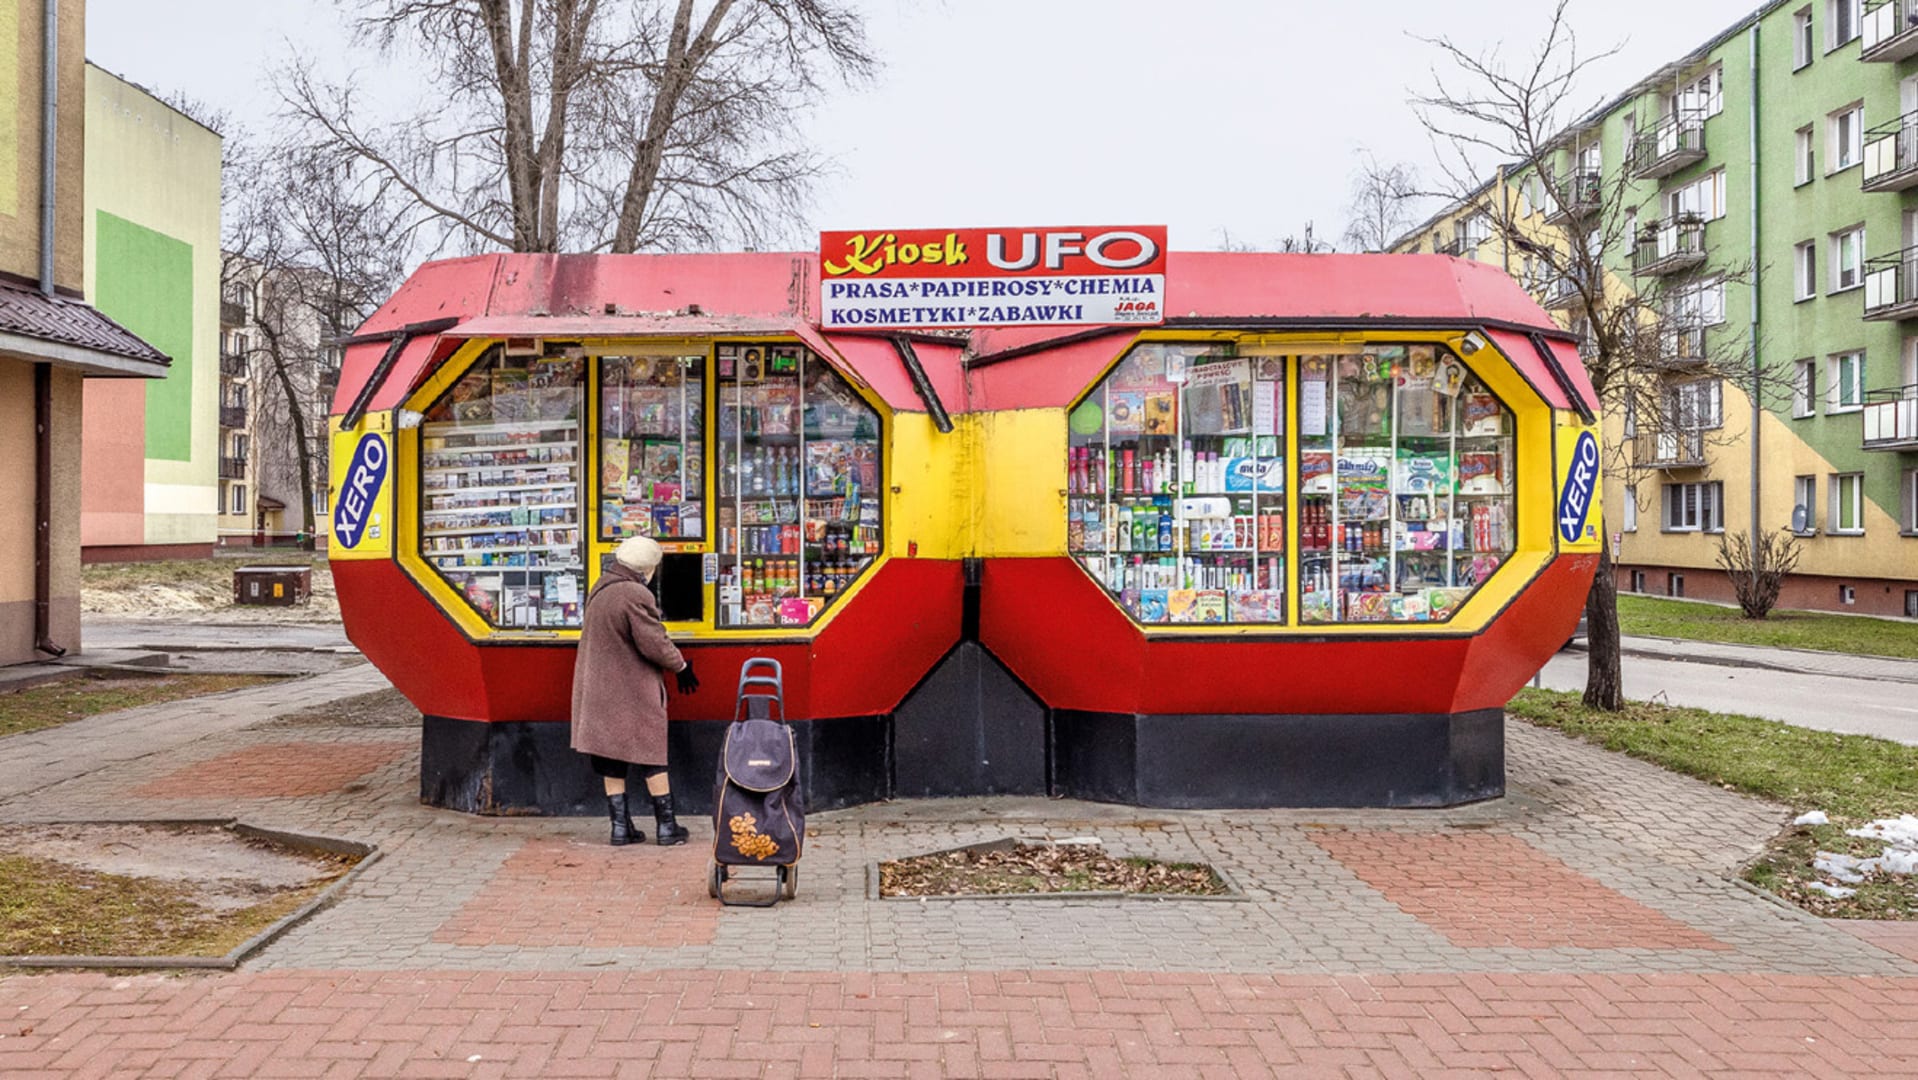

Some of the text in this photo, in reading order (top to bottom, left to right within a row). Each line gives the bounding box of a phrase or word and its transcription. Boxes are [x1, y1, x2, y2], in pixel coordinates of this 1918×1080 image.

[823, 231, 1159, 276] Kiosk UFO
[336, 439, 384, 547] XERO
[1560, 437, 1597, 541] XERO
